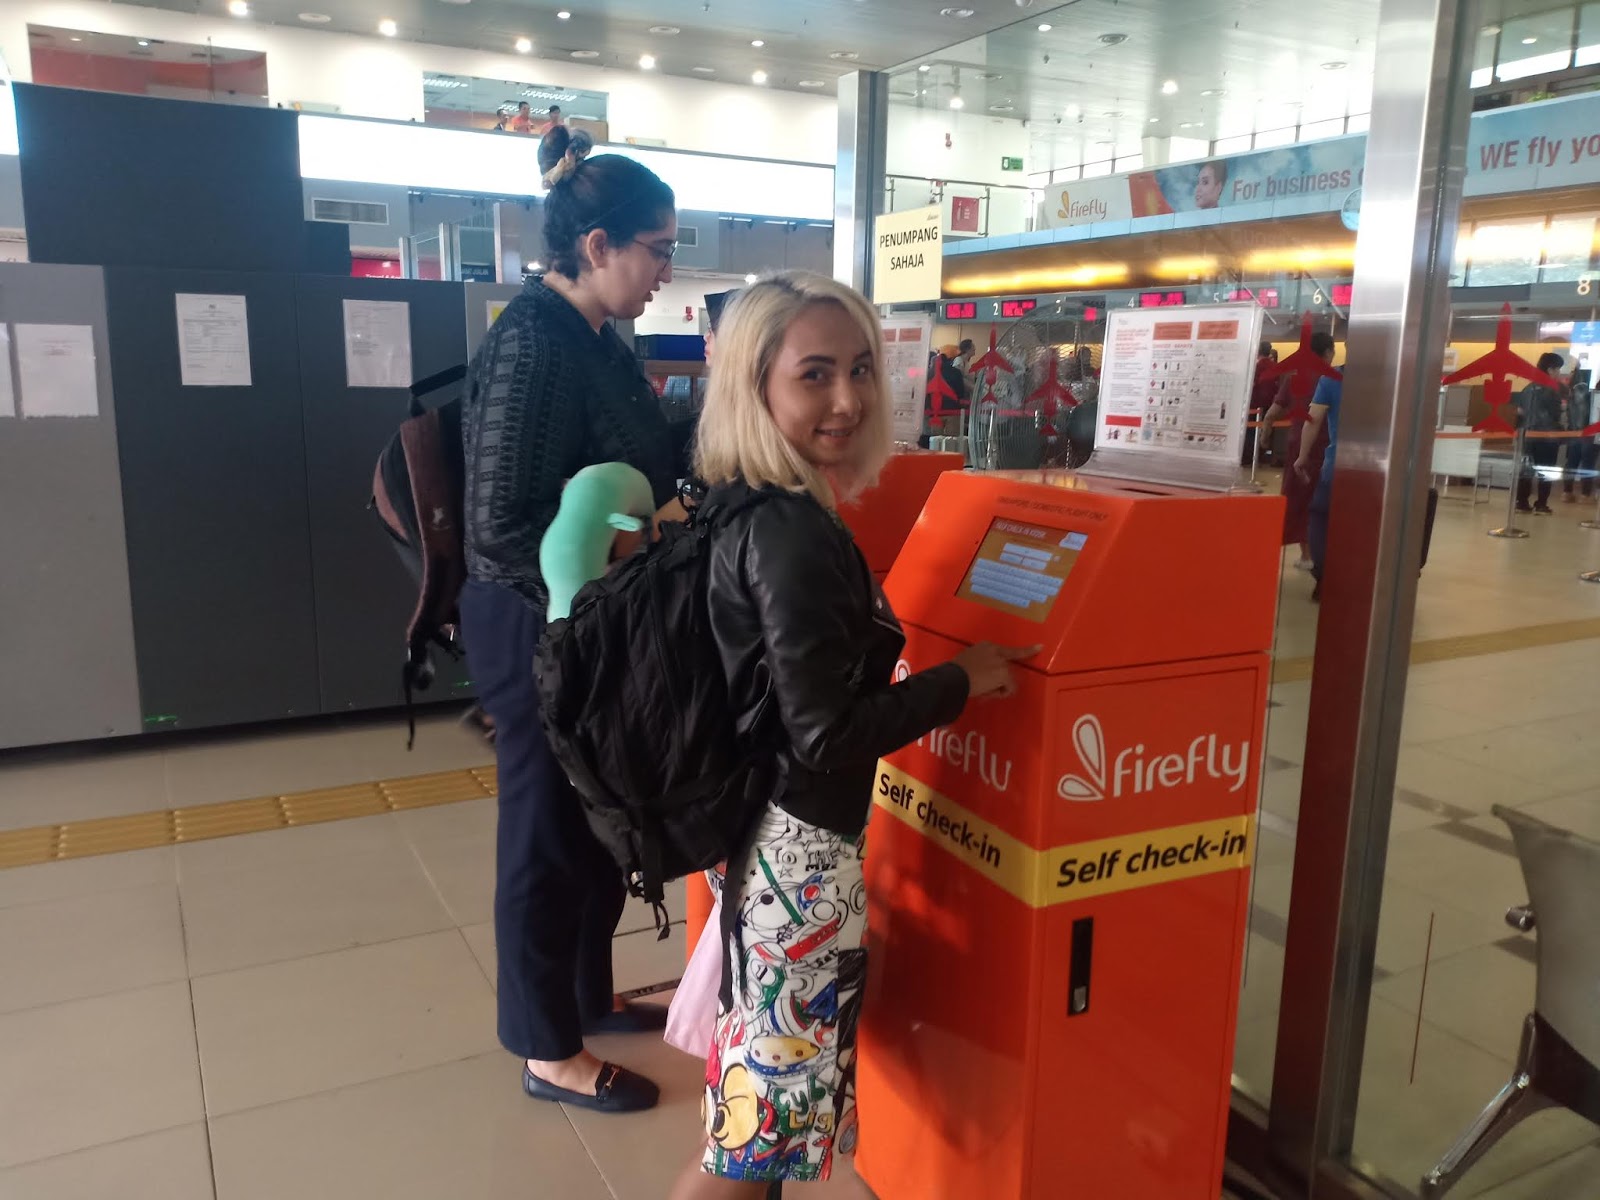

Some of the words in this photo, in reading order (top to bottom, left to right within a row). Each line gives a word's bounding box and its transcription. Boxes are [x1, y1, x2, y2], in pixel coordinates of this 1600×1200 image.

[1480, 139, 1520, 171] WE
[1528, 136, 1562, 167] fly
[1232, 179, 1260, 200] For
[1266, 167, 1351, 197] business
[1070, 198, 1107, 220] firefly
[879, 226, 938, 248] PENUMPANG
[890, 253, 925, 270] SAHAJA
[1576, 274, 1591, 295] 8
[1127, 297, 1135, 309] 4
[1312, 288, 1322, 305] 6
[992, 302, 999, 316] 2
[1113, 733, 1250, 798] firefly
[879, 773, 915, 811] Self
[917, 801, 1001, 868] check-in
[1056, 850, 1122, 888] Self
[1125, 830, 1247, 875] check-in
